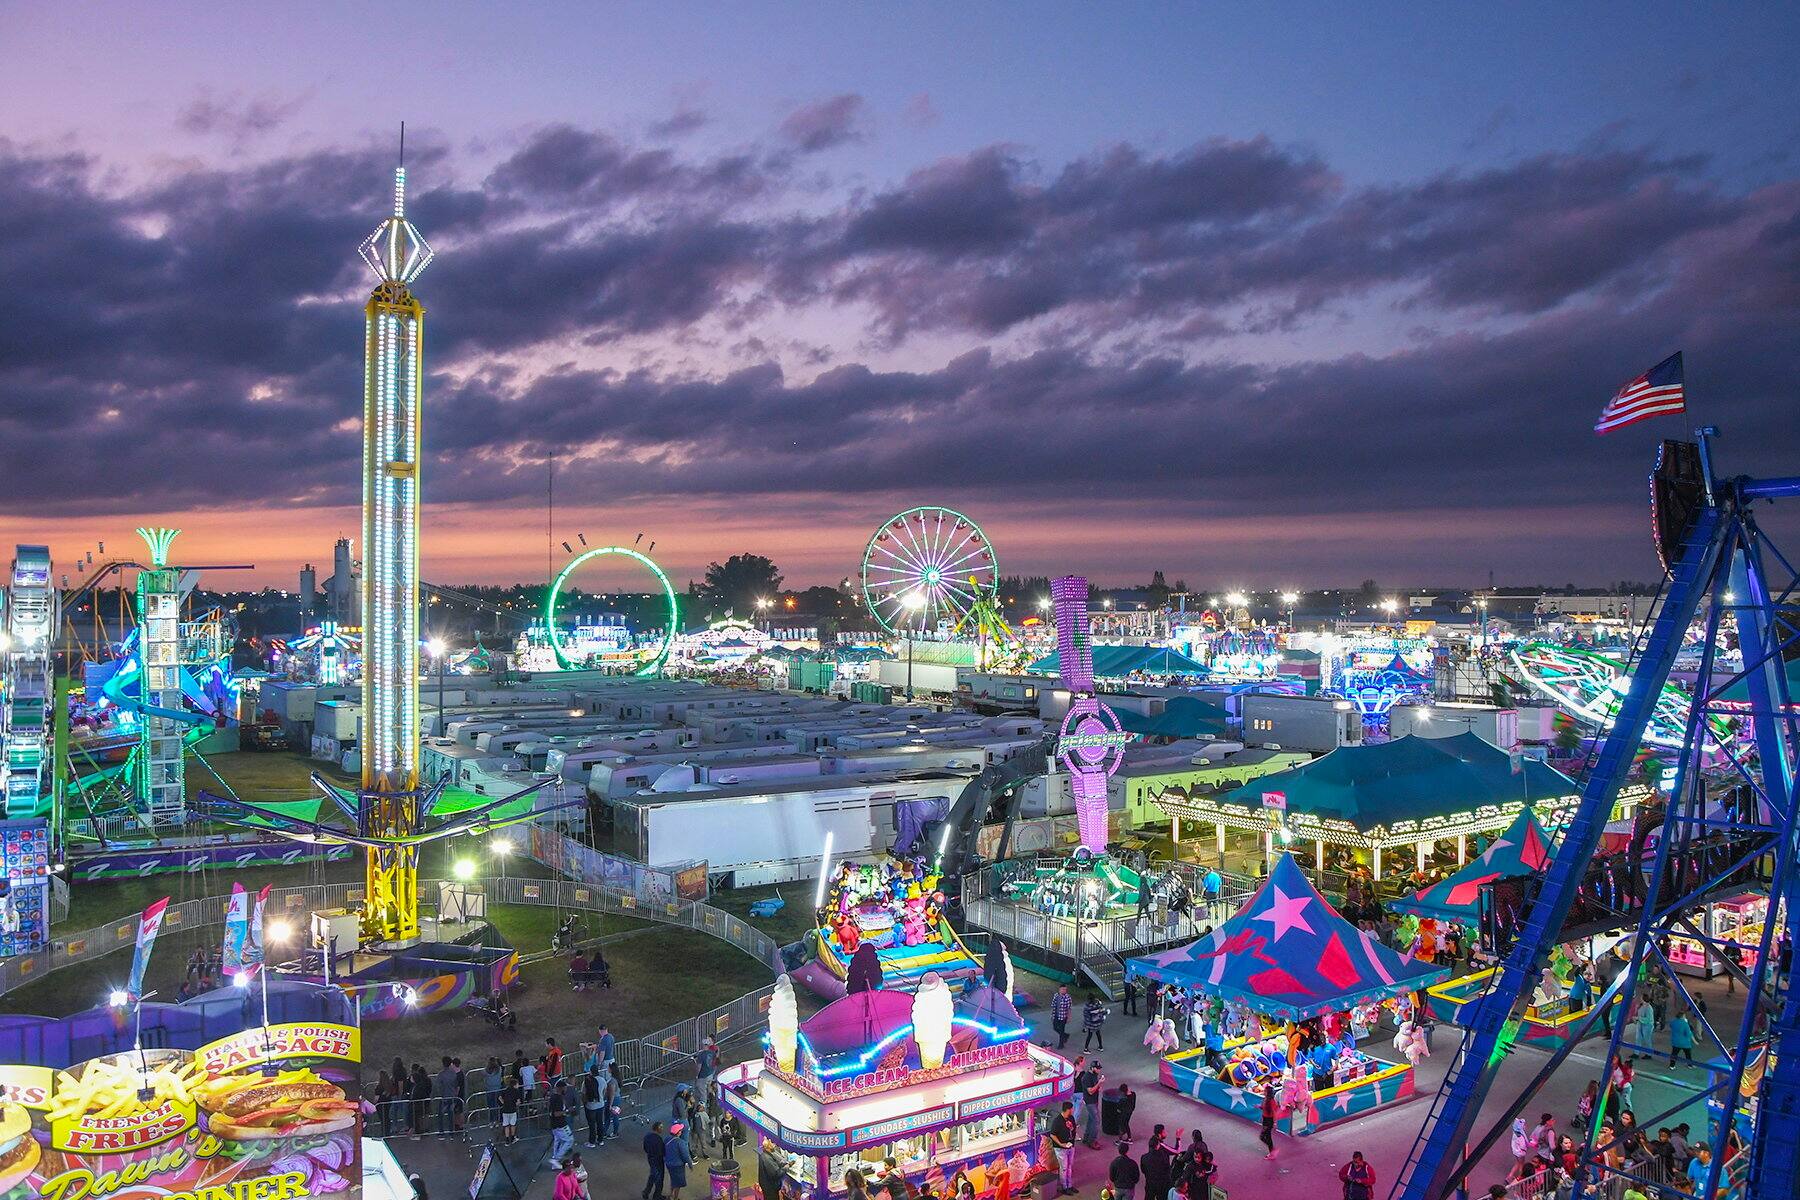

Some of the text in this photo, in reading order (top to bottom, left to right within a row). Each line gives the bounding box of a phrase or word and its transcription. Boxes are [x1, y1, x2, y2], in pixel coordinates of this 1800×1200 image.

[277, 1029, 288, 1038] &
[294, 1027, 351, 1040] POLISH
[205, 1038, 351, 1074] SAUSAGE
[949, 1039, 1028, 1069] MILKSHAKES
[825, 1079, 851, 1096] ICE
[851, 1064, 910, 1090] CREAM
[80, 1102, 174, 1130] FRENCH
[963, 1100, 991, 1114] DIPPED
[991, 1094, 1015, 1107] CONES
[65, 1113, 187, 1150] FRIES
[869, 1120, 908, 1137] SUNDAES
[912, 1109, 951, 1126] SLUSHIES
[783, 1130, 840, 1146] MILKSHAKES
[40, 1127, 226, 1200] Dawn's
